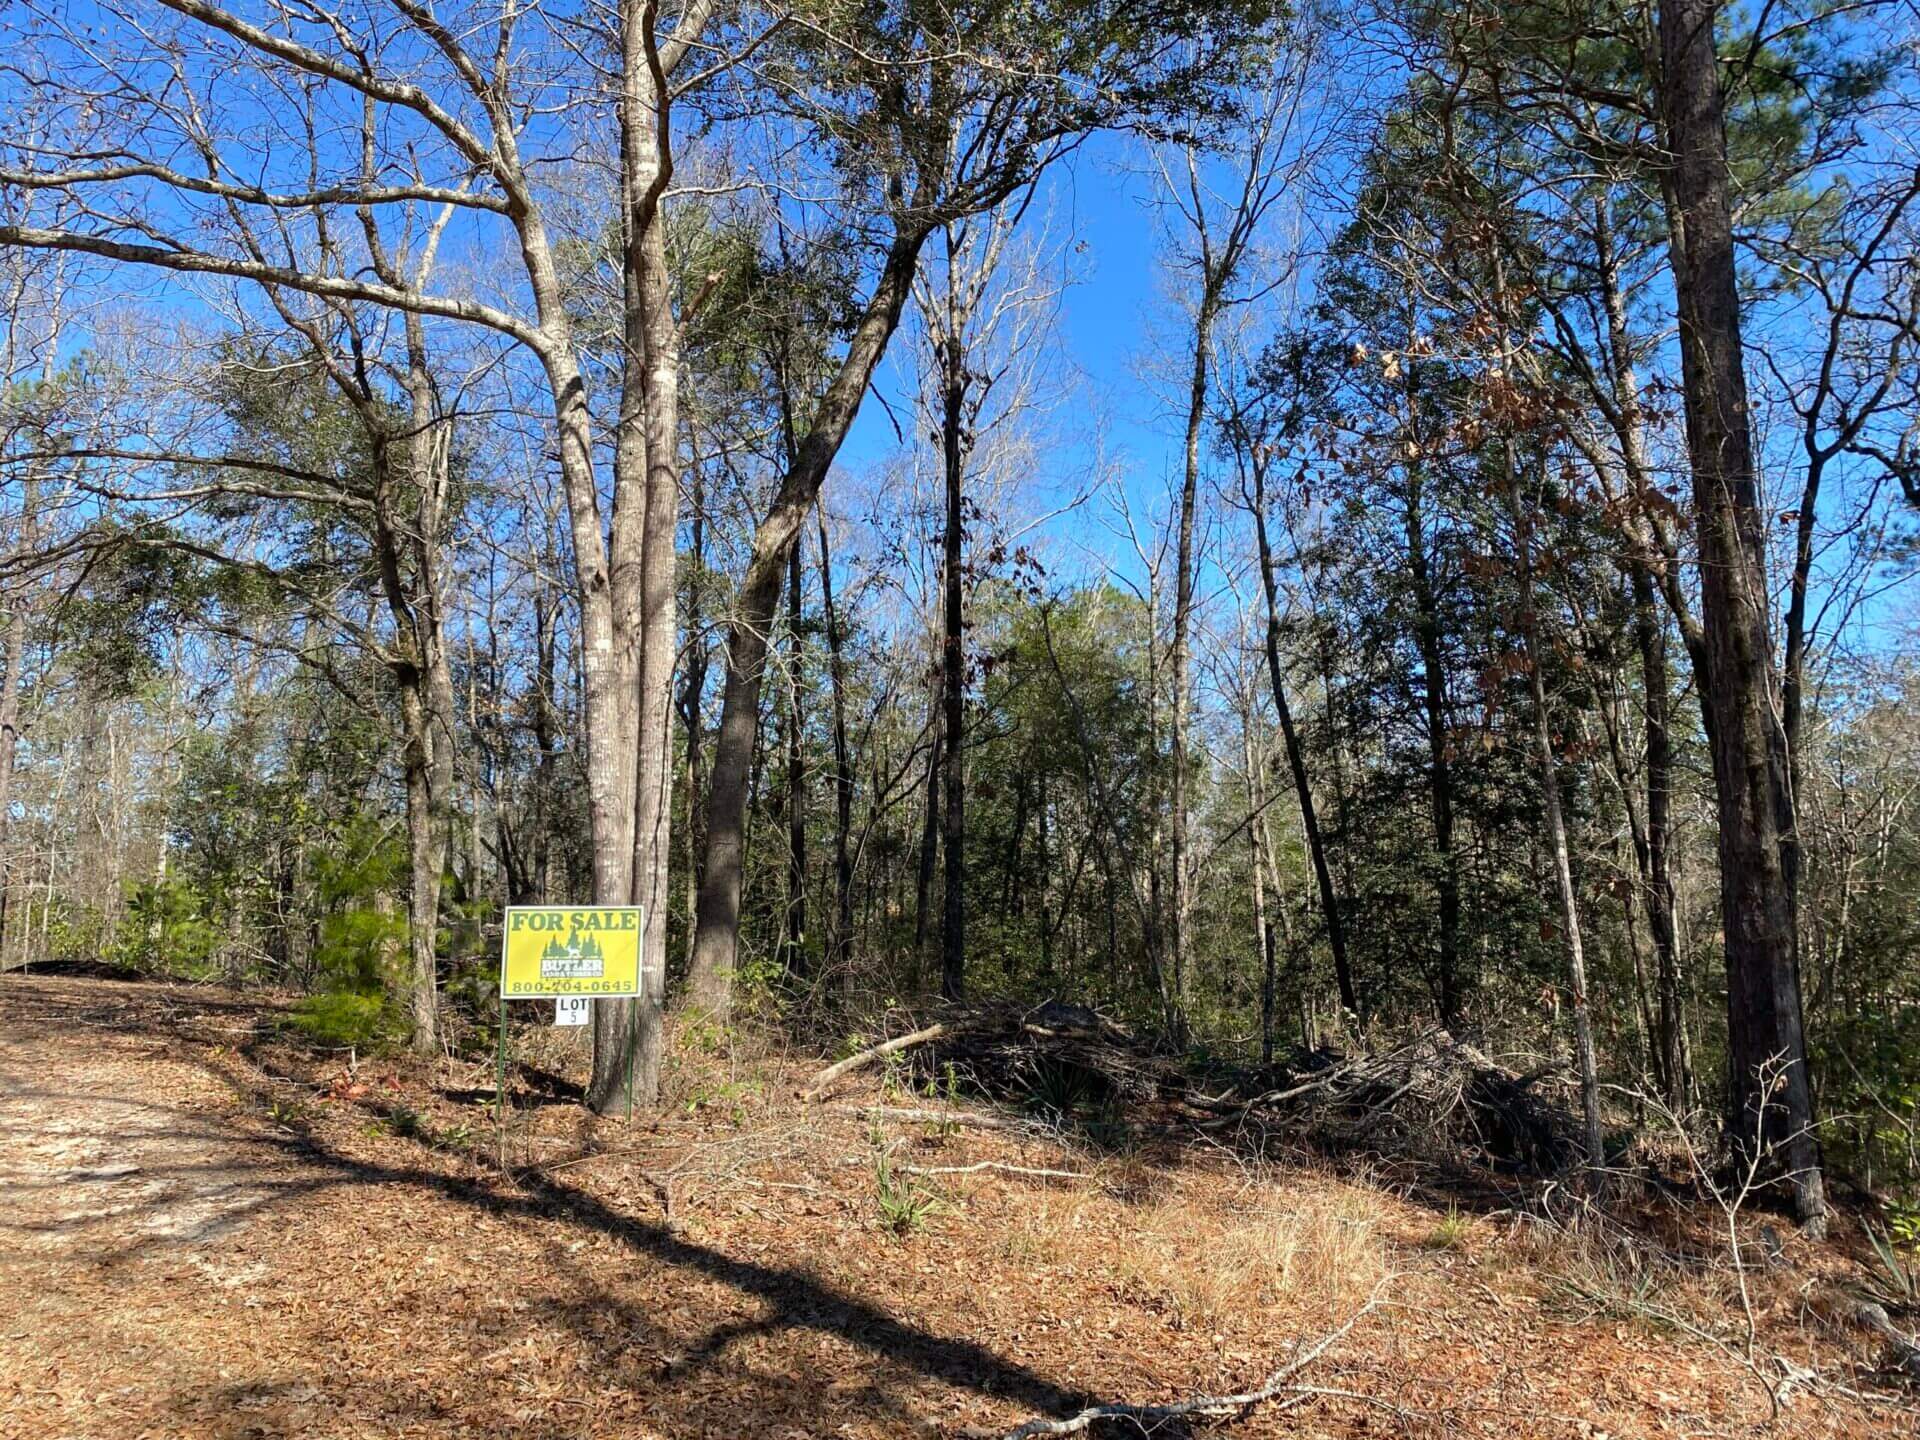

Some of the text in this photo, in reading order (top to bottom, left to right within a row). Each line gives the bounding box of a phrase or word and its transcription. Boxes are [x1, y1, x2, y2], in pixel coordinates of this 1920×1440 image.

[511, 912, 636, 931] FOR SALE
[542, 959, 602, 971] BUTLER
[512, 982, 632, 992] 800-704-0645
[560, 999, 587, 1011] LOT
[570, 1012, 577, 1023] 5
